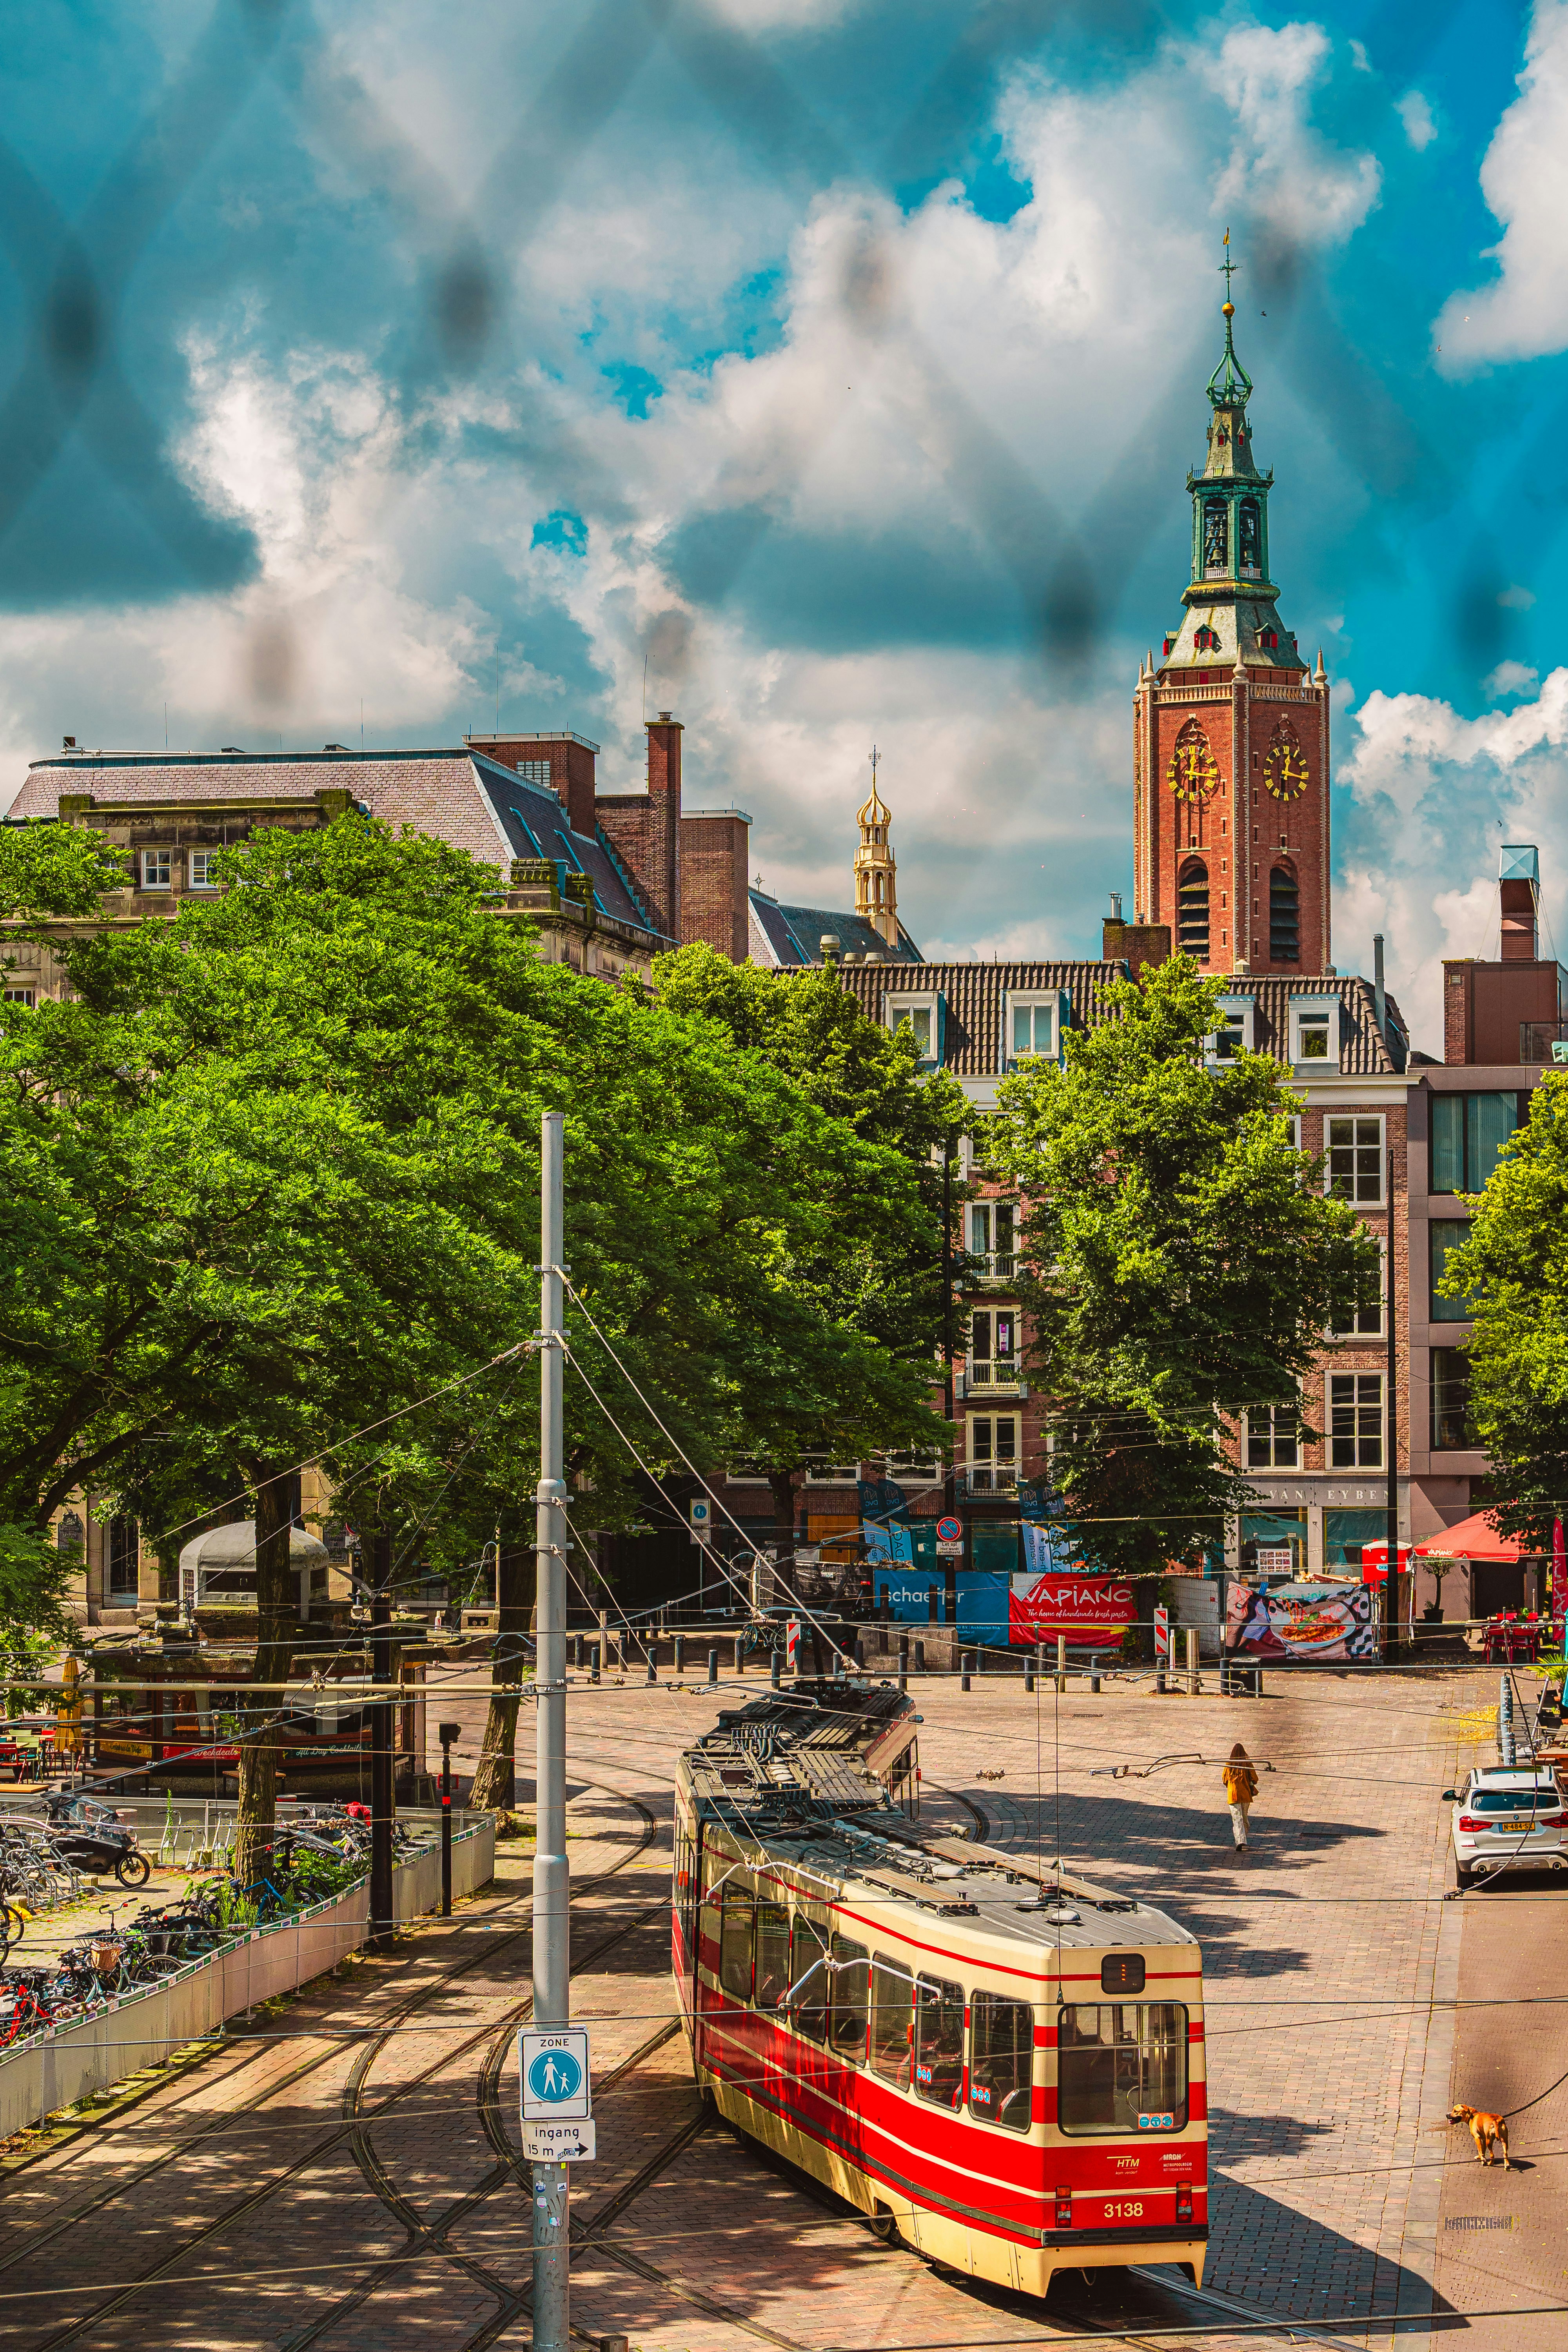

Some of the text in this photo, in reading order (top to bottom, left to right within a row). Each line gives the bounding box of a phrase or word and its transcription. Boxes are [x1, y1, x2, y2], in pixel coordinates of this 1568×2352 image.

[1269, 1490, 1303, 1499] VAN
[1038, 1609, 1055, 1617] home
[1056, 1610, 1063, 1618] of
[1063, 1609, 1094, 1617] handmade
[1095, 1610, 1110, 1618] fresh
[1111, 1610, 1128, 1621] pasta
[296, 1747, 309, 1758] All
[310, 1746, 328, 1757] Day
[329, 1744, 363, 1754] Cocktails
[540, 2038, 569, 2047] ZONE
[535, 2127, 579, 2141] ingang
[528, 2143, 554, 2156] 15 m
[1117, 2158, 1140, 2167] HTM
[1104, 2202, 1143, 2218] 3138
